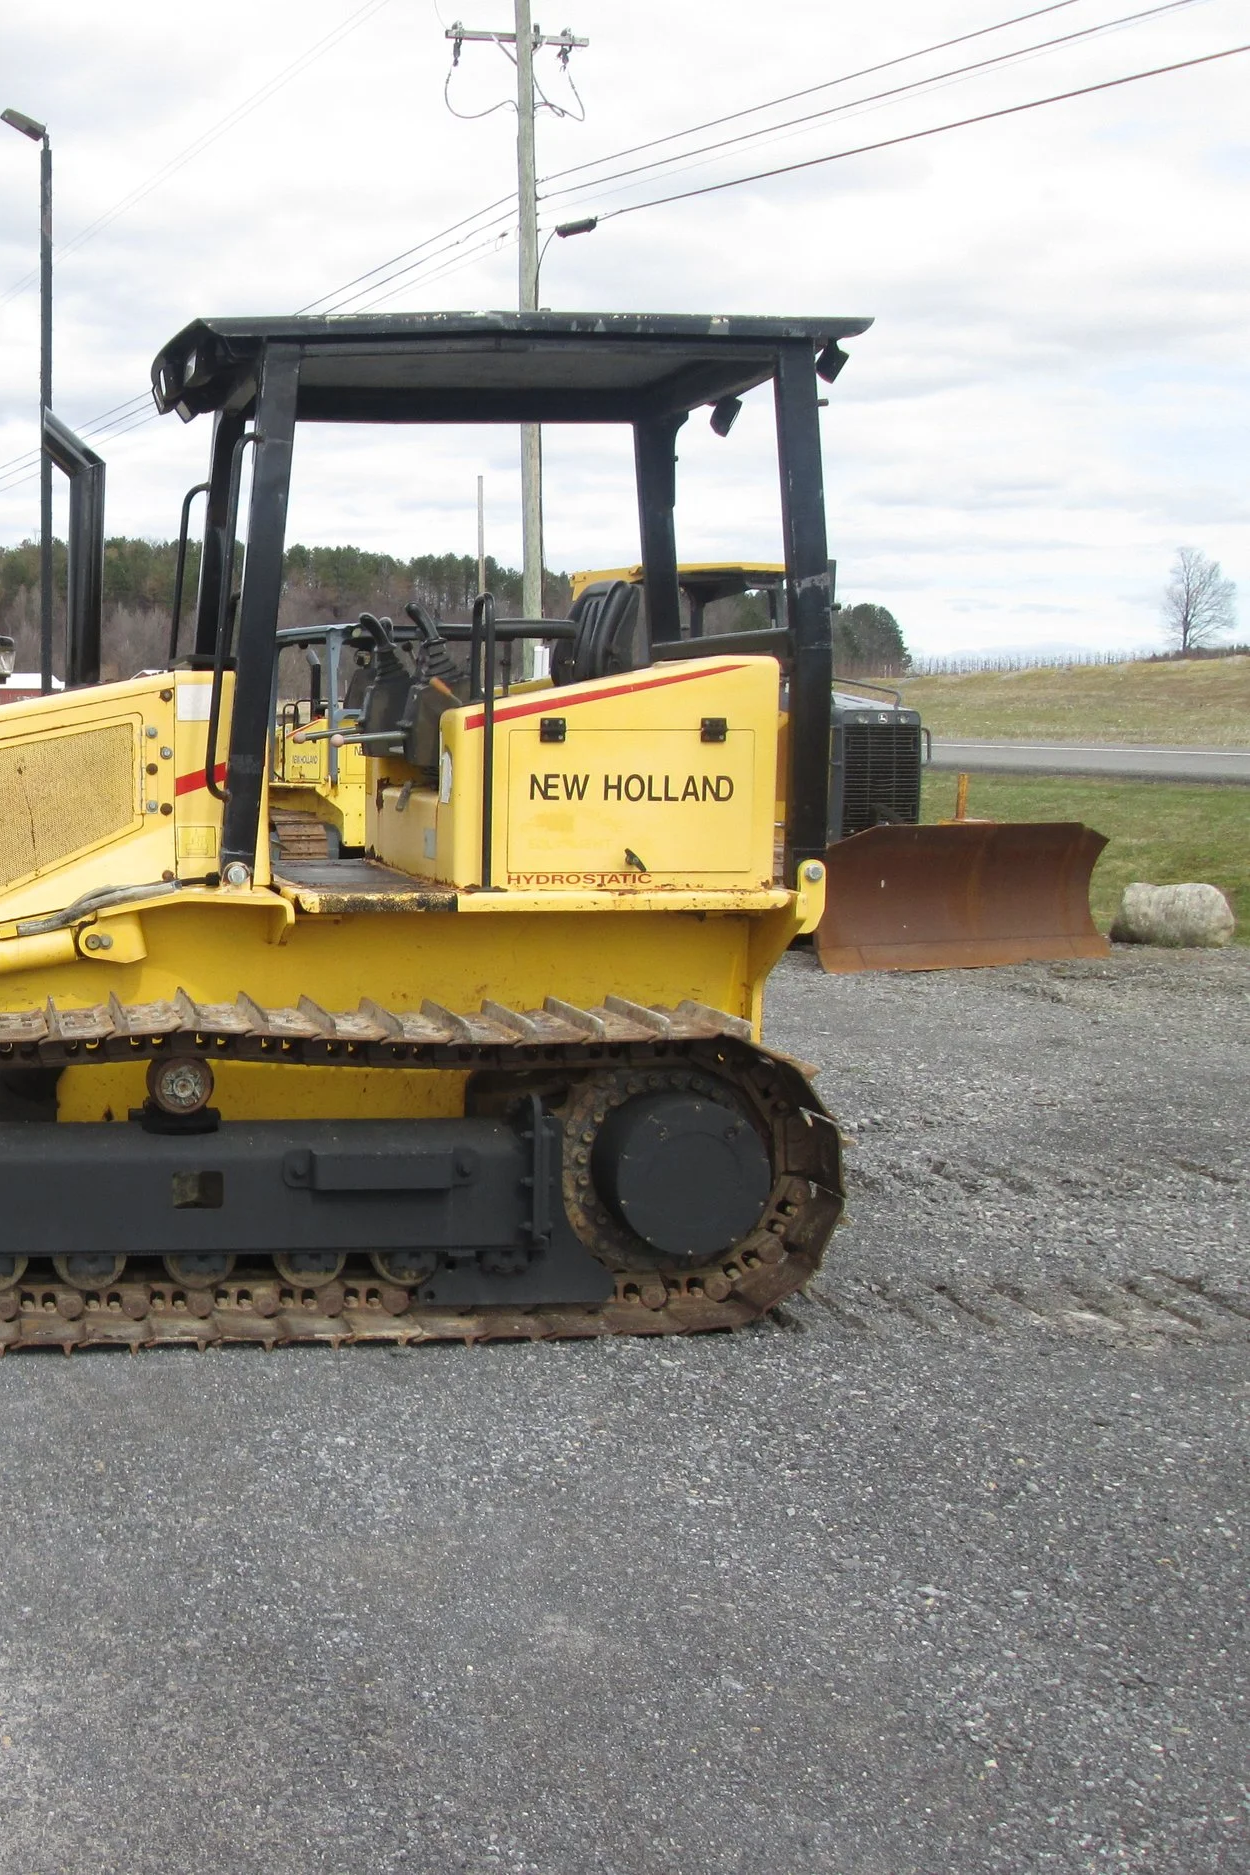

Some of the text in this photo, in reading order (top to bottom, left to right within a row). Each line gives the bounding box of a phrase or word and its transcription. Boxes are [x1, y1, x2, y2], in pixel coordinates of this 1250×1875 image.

[301, 755, 318, 765] HOLLAND
[529, 773, 734, 802] NEW HOLLAND
[507, 872, 652, 886] HYDROSTATIC
